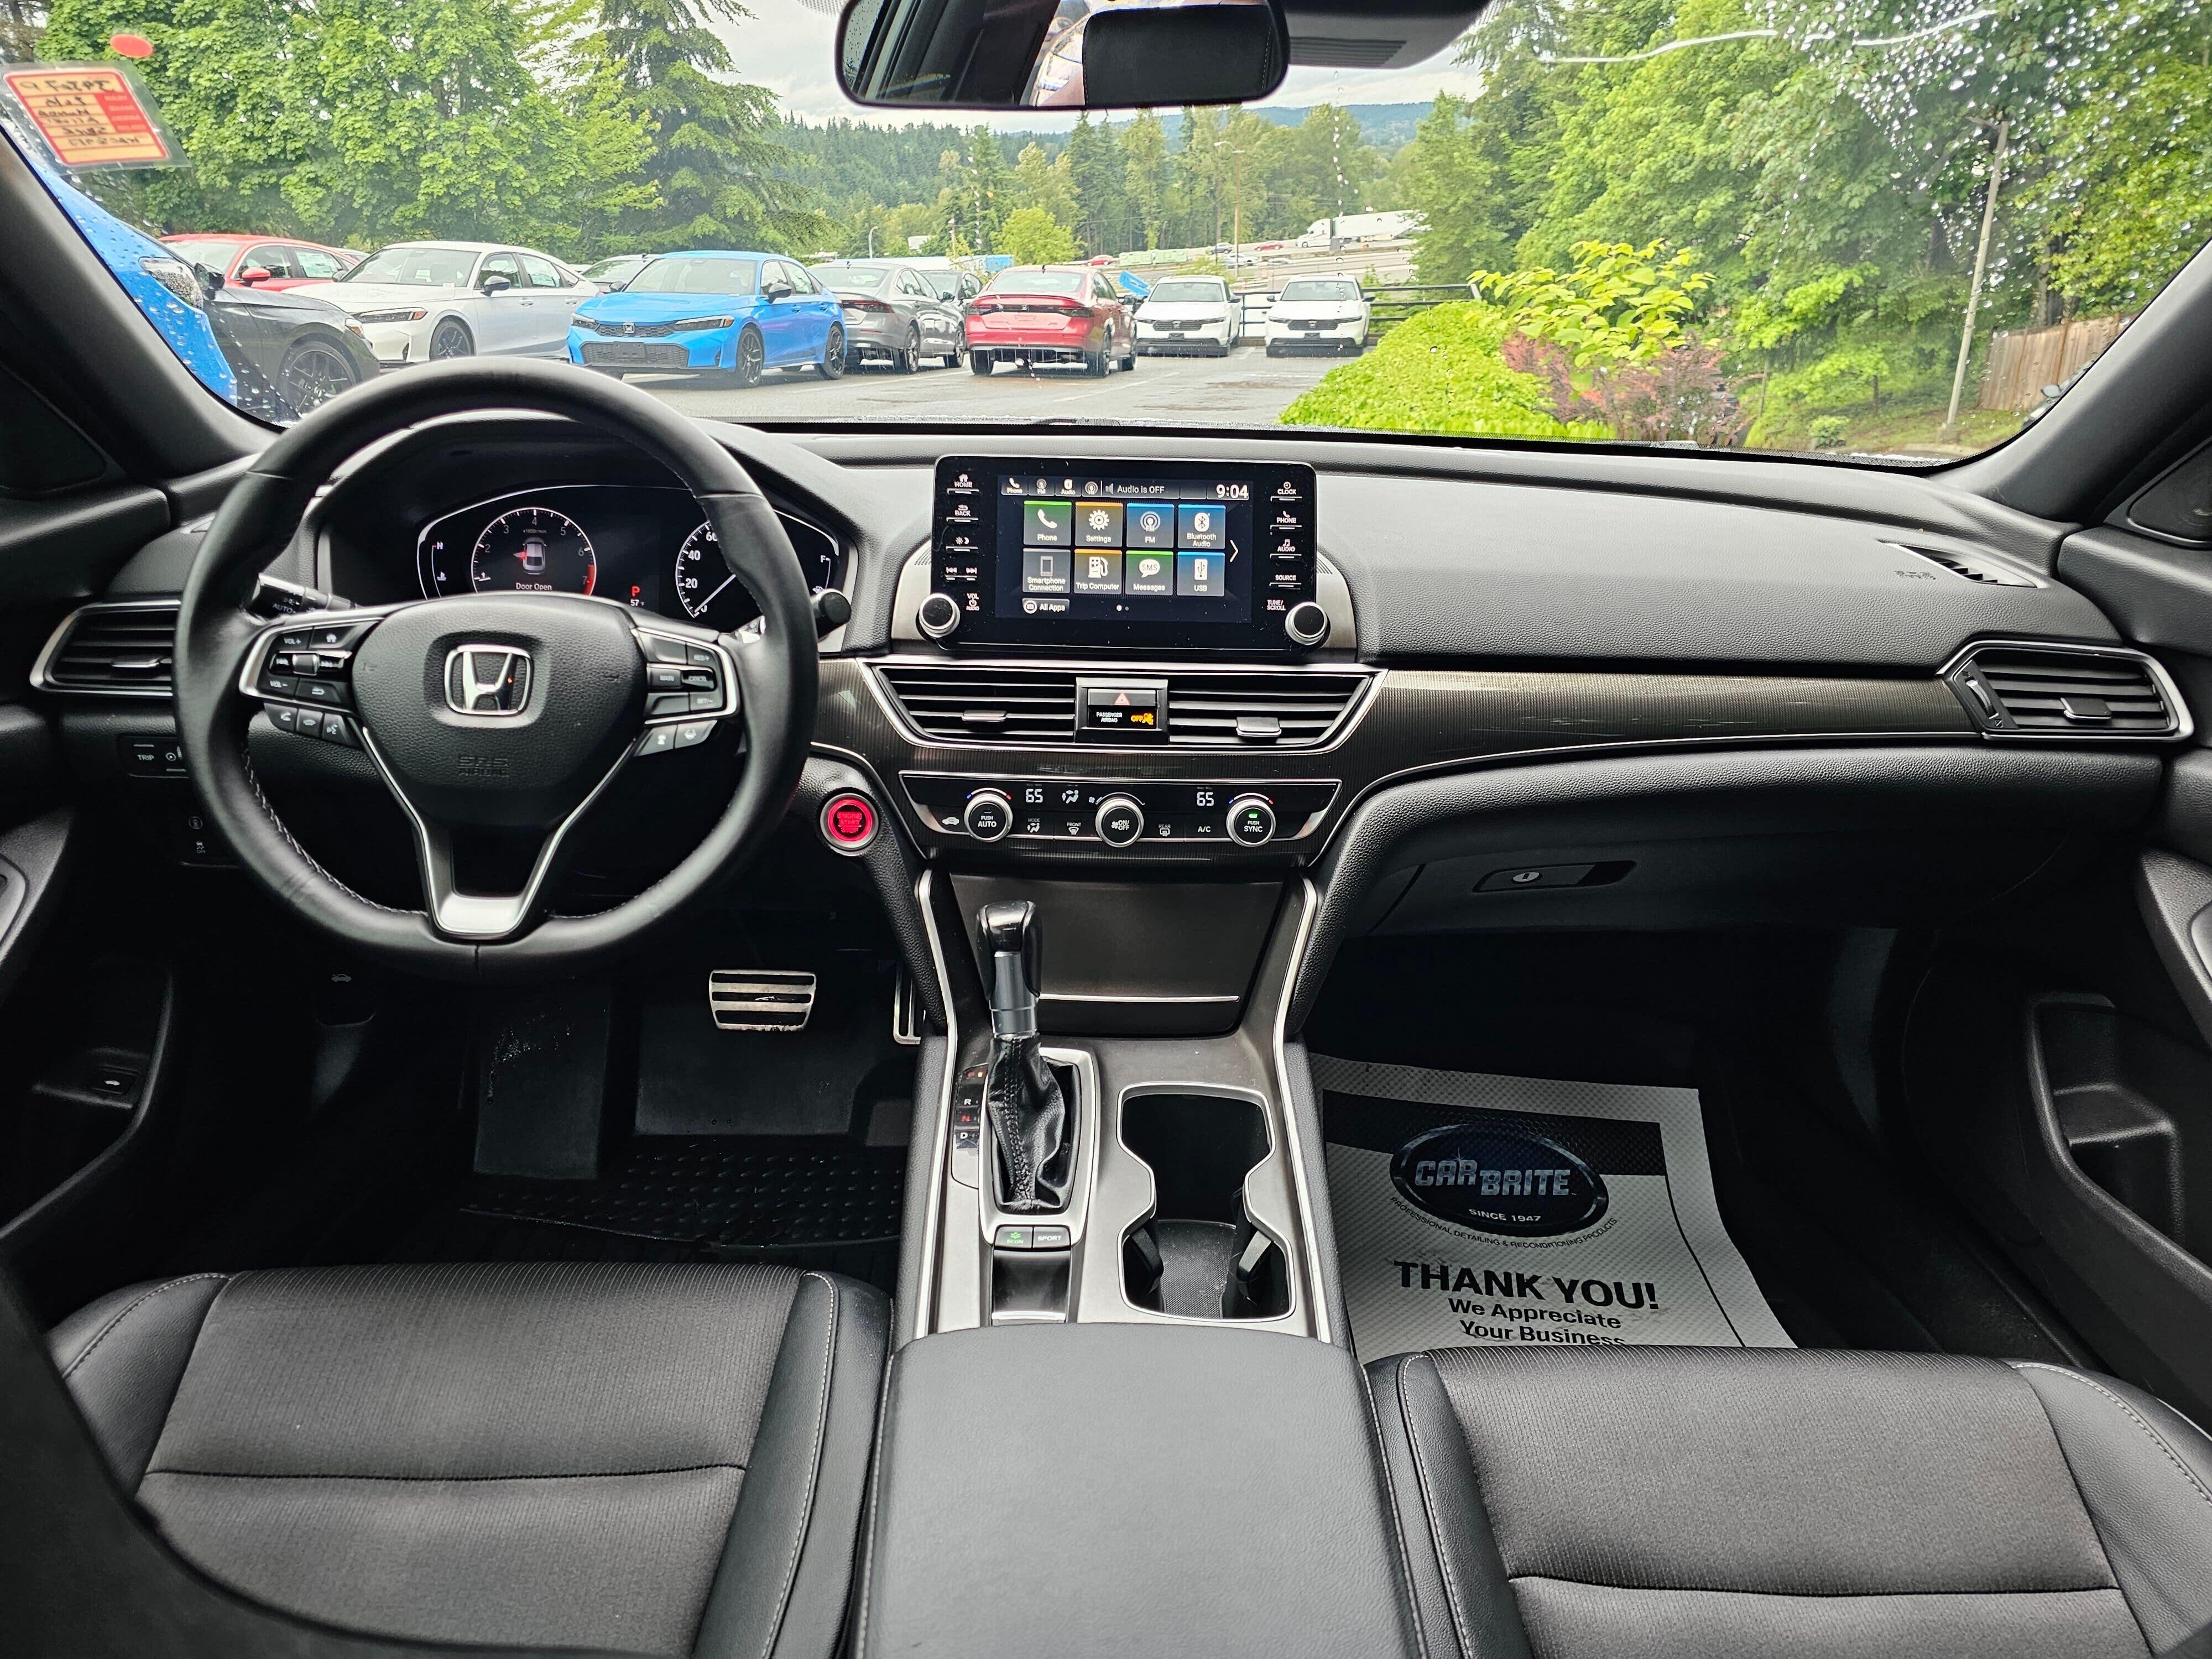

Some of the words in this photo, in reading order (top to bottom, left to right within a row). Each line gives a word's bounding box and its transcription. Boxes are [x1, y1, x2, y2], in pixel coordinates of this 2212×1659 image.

[1117, 485, 1139, 494] Audio
[1216, 484, 1249, 498] 9:04
[531, 517, 537, 525] 4
[504, 525, 509, 534] 3
[560, 526, 566, 536] 5
[706, 531, 718, 541] 60
[1086, 535, 1112, 544] Settings
[436, 541, 444, 550] H
[485, 544, 491, 553] 2
[578, 547, 584, 556] 6
[688, 550, 701, 560] 40
[820, 555, 826, 563] F
[582, 576, 587, 585] 7
[685, 577, 698, 588] 20
[1027, 576, 1066, 585] Smartphone
[534, 583, 552, 591] Open
[632, 586, 640, 597] P
[1076, 582, 1088, 591] Trip
[1089, 583, 1120, 592] Computer
[1133, 583, 1165, 592] Messages
[272, 603, 293, 614] AUTO
[1049, 604, 1066, 612] Apps
[1026, 789, 1044, 803] 65
[1197, 792, 1214, 806] 65
[1414, 1160, 1478, 1186] CAR
[1480, 1169, 1571, 1196] BRITE
[1469, 1208, 1506, 1221] SINCE
[1390, 1197, 1452, 1235] PROFESSIONAL
[1454, 1230, 1500, 1245] DETAILING
[1510, 1238, 1583, 1249] RECONDITIONING
[1583, 1218, 1618, 1241] PRODUCTS
[1394, 1260, 1546, 1301] THANK
[1552, 1276, 1659, 1310] YOU!
[1448, 1298, 1485, 1316] We
[1491, 1303, 1621, 1329] Appreciate
[1459, 1319, 1514, 1340] Your
